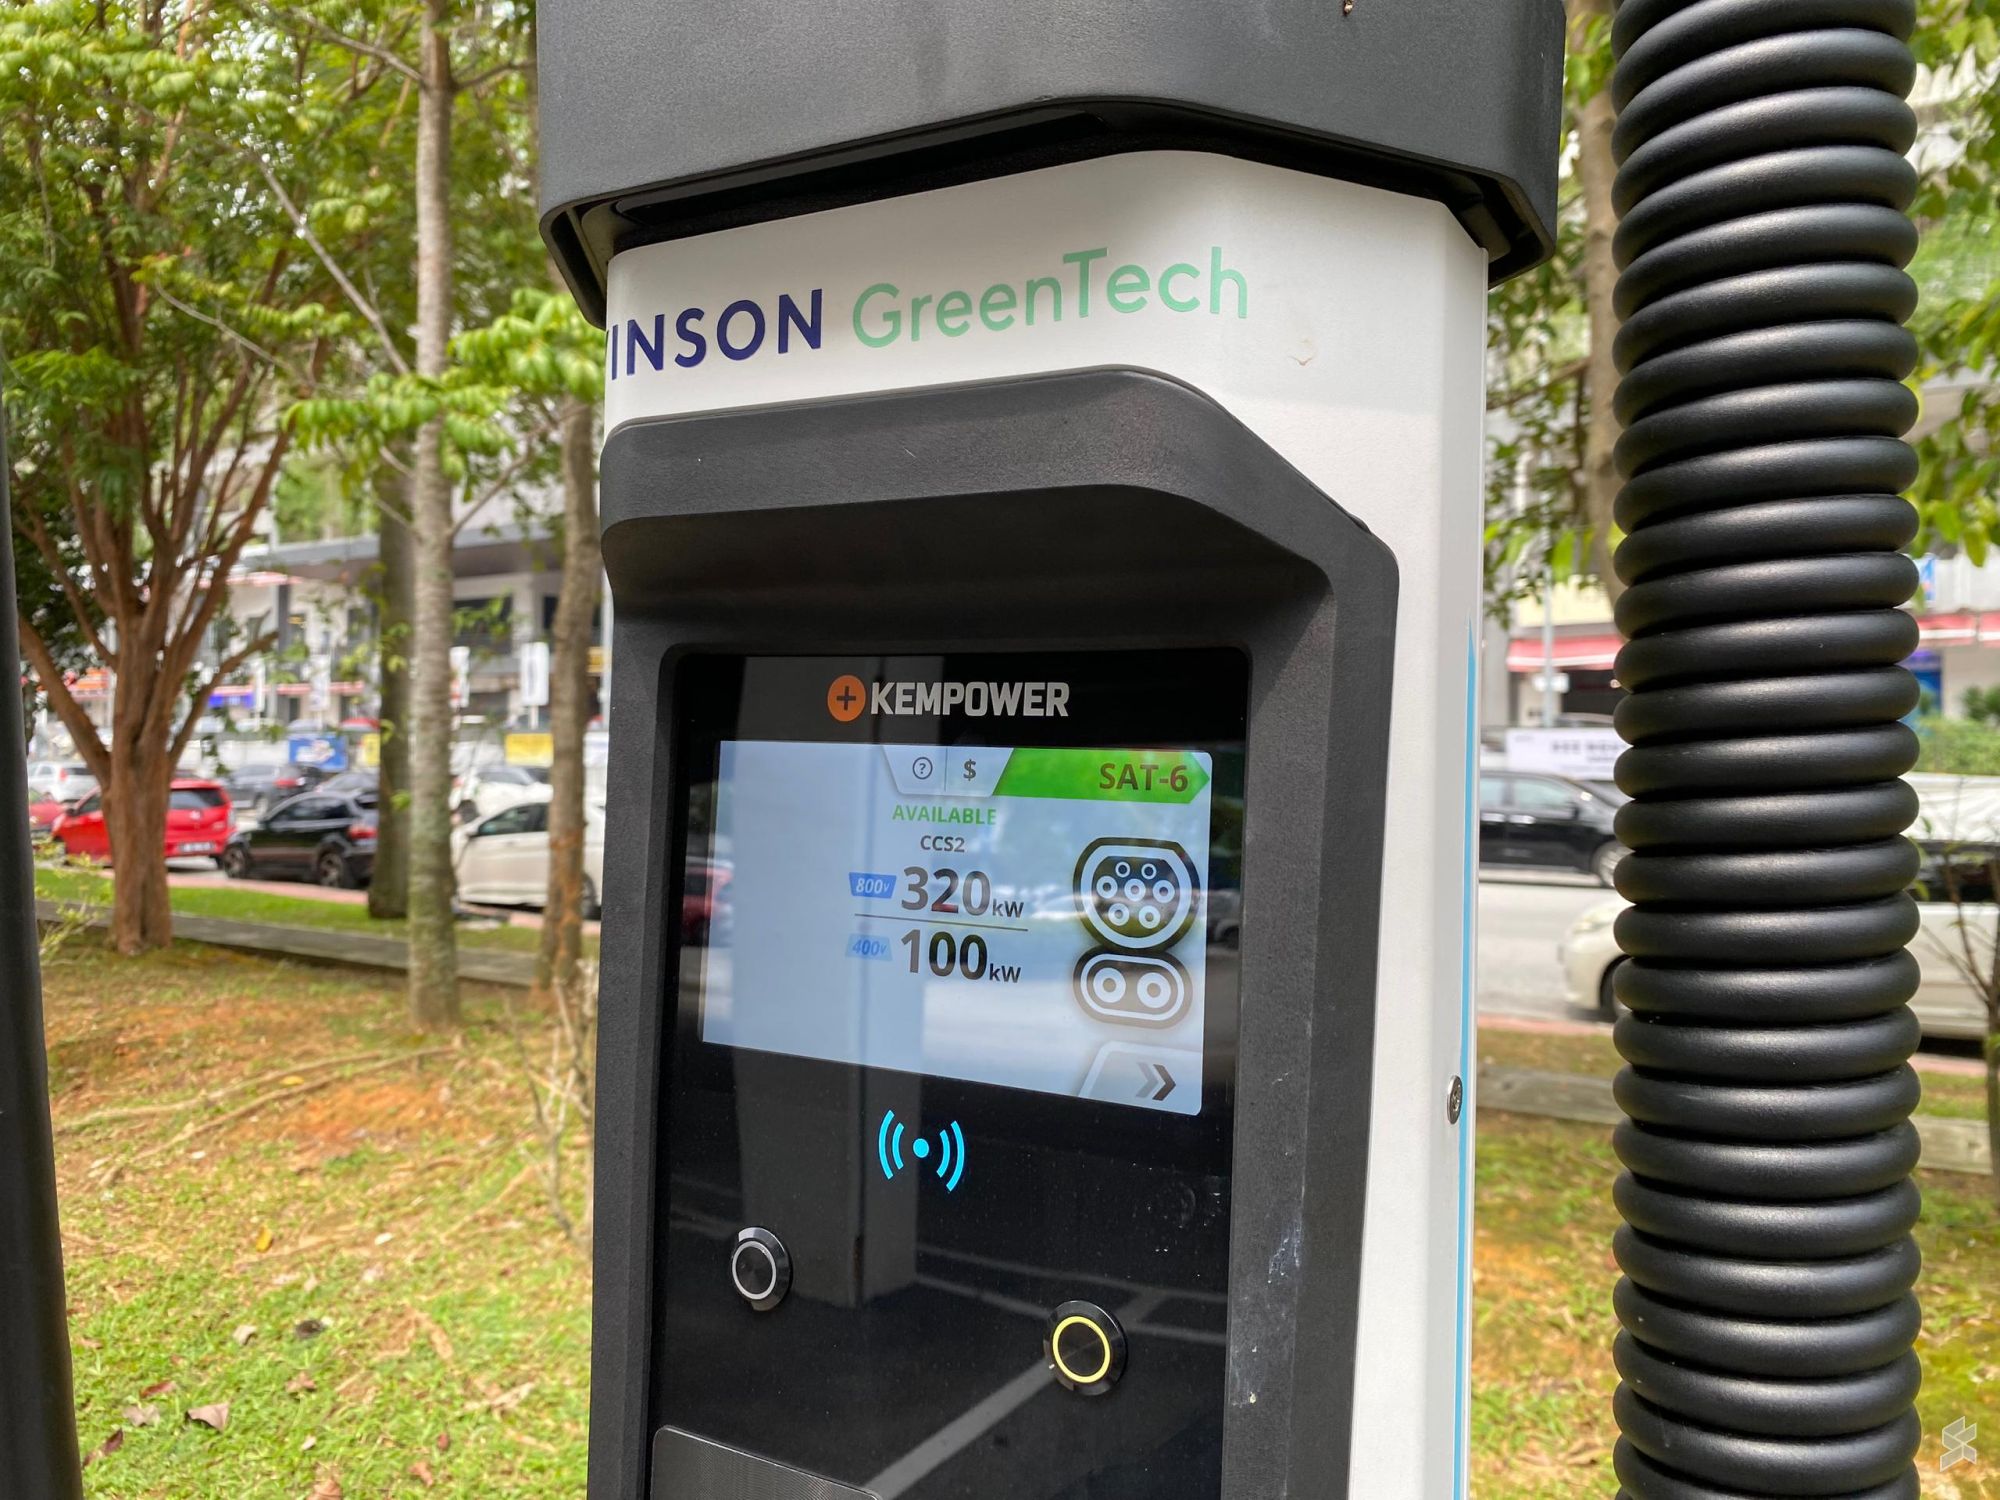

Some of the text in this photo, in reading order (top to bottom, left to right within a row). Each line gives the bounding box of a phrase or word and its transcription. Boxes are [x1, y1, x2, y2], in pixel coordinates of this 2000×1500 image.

[606, 246, 1248, 381] INSON GreenTech
[870, 681, 1070, 717] KEMPOWER
[963, 759, 977, 781] $
[1099, 762, 1189, 792] SAT-6
[892, 804, 998, 826] AVAILABLE
[920, 834, 966, 853] CCS2
